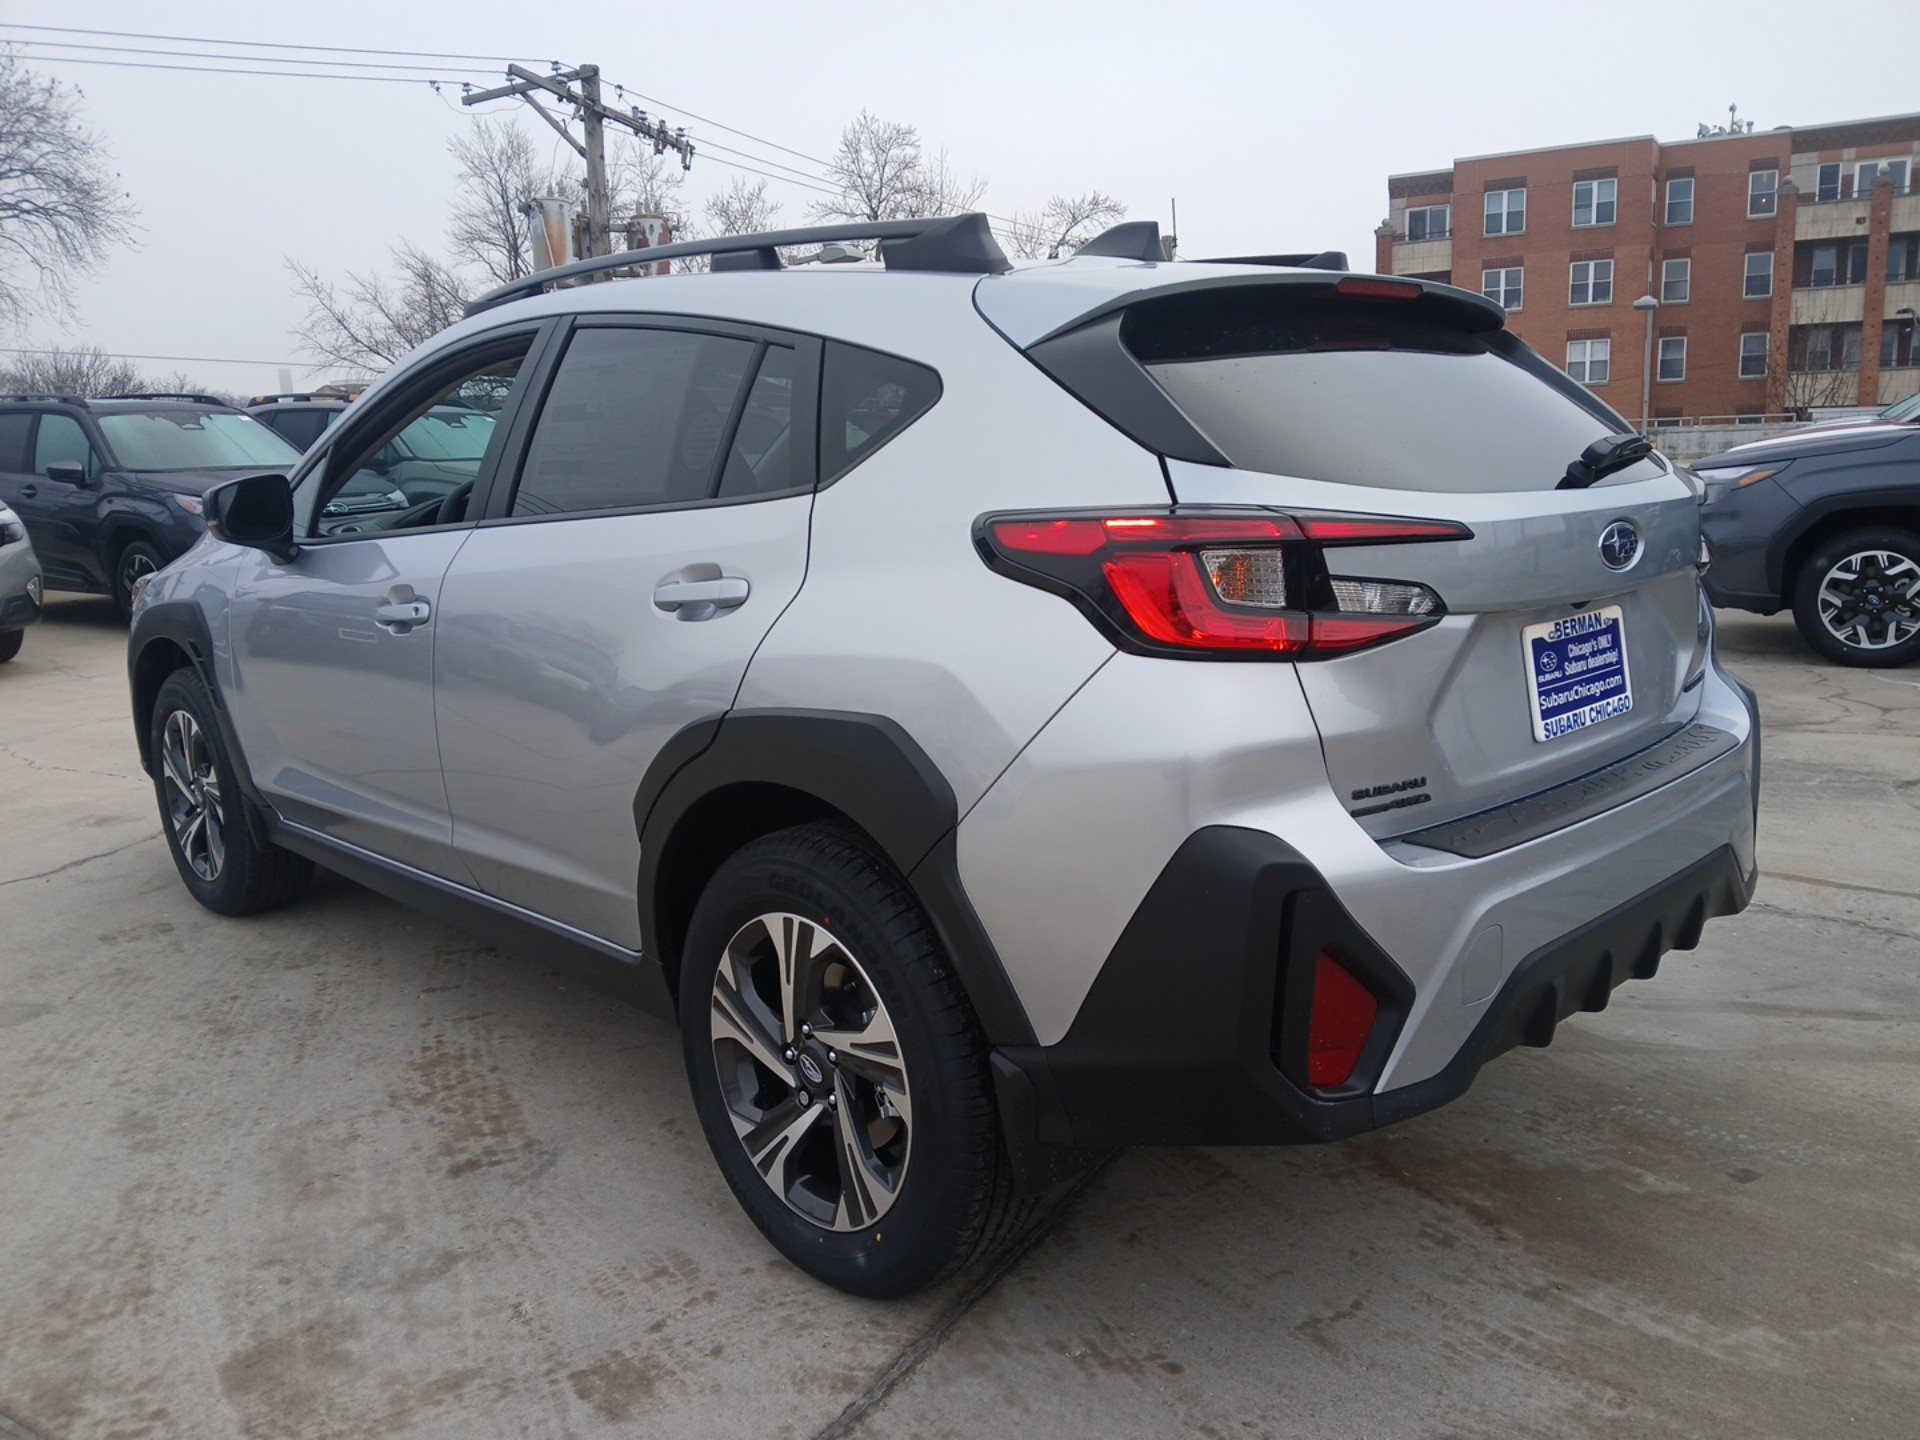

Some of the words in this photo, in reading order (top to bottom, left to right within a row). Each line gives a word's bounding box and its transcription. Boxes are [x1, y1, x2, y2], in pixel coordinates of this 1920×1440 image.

[1554, 611, 1602, 639] BERMAN
[1568, 639, 1598, 658] Chicago's
[1598, 634, 1612, 650] ONLY
[1564, 661, 1587, 676] Subaru
[1588, 648, 1619, 669] dealership!
[1538, 670, 1563, 683] SUBARU
[1540, 675, 1622, 710] SubaruChicago.com
[1543, 711, 1586, 739] SUBARU
[1589, 695, 1630, 723] CHICAGO
[1351, 776, 1427, 800] SUBARU
